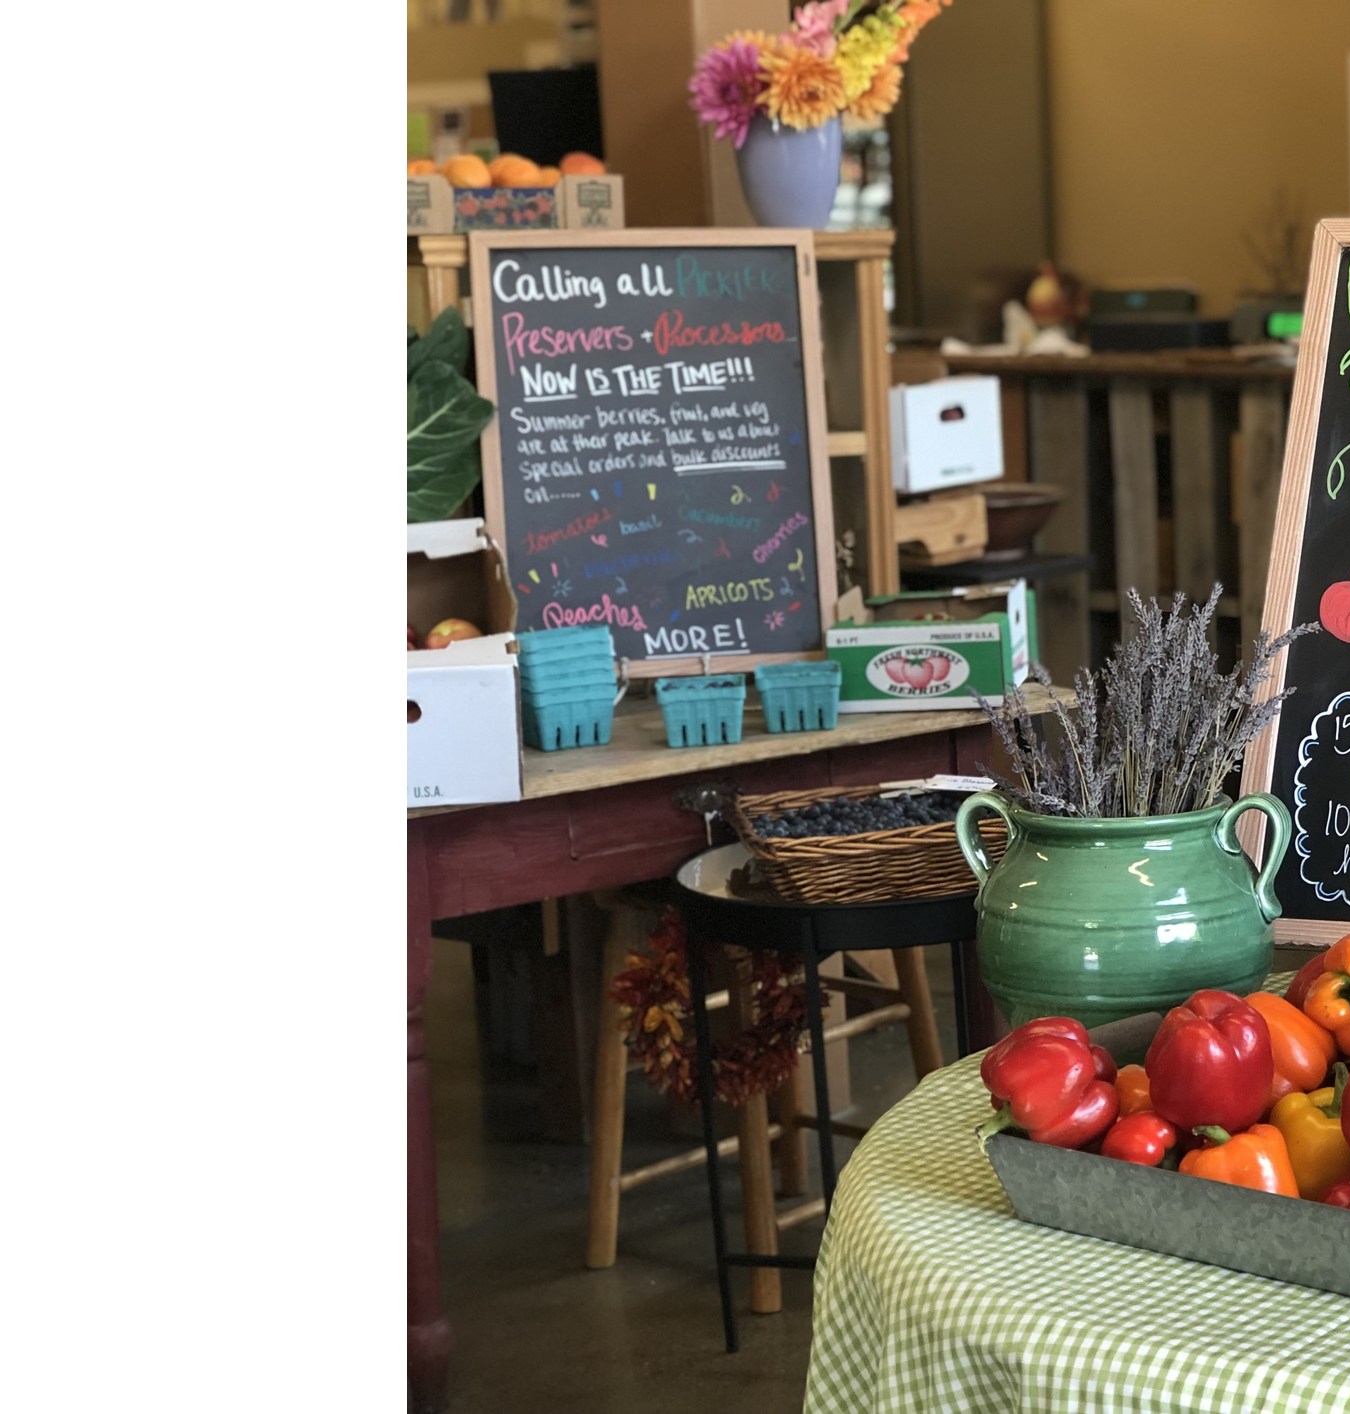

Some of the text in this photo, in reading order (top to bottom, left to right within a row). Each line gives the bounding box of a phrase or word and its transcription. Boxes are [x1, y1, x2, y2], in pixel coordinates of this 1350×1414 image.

[493, 259, 607, 309] Calling
[616, 263, 673, 297] all
[502, 311, 634, 376] Preservers
[519, 356, 756, 400] NOW IS THE TIME!!!
[510, 406, 592, 434] Summer
[710, 401, 741, 419] and
[743, 401, 770, 425] veg
[517, 438, 546, 456] are
[550, 435, 569, 453] at
[662, 427, 697, 447] Talk
[701, 427, 716, 443] to
[717, 426, 735, 441] us
[737, 422, 780, 439] about
[588, 453, 636, 474] orders
[639, 449, 667, 469] and
[670, 448, 707, 467] bulk
[711, 442, 781, 464] discounts
[685, 577, 775, 611] APRICOTS
[543, 593, 648, 631] Peaches
[643, 617, 750, 655] MORE!
[887, 681, 951, 696] BERRIES
[413, 785, 444, 799] U.S.A.
